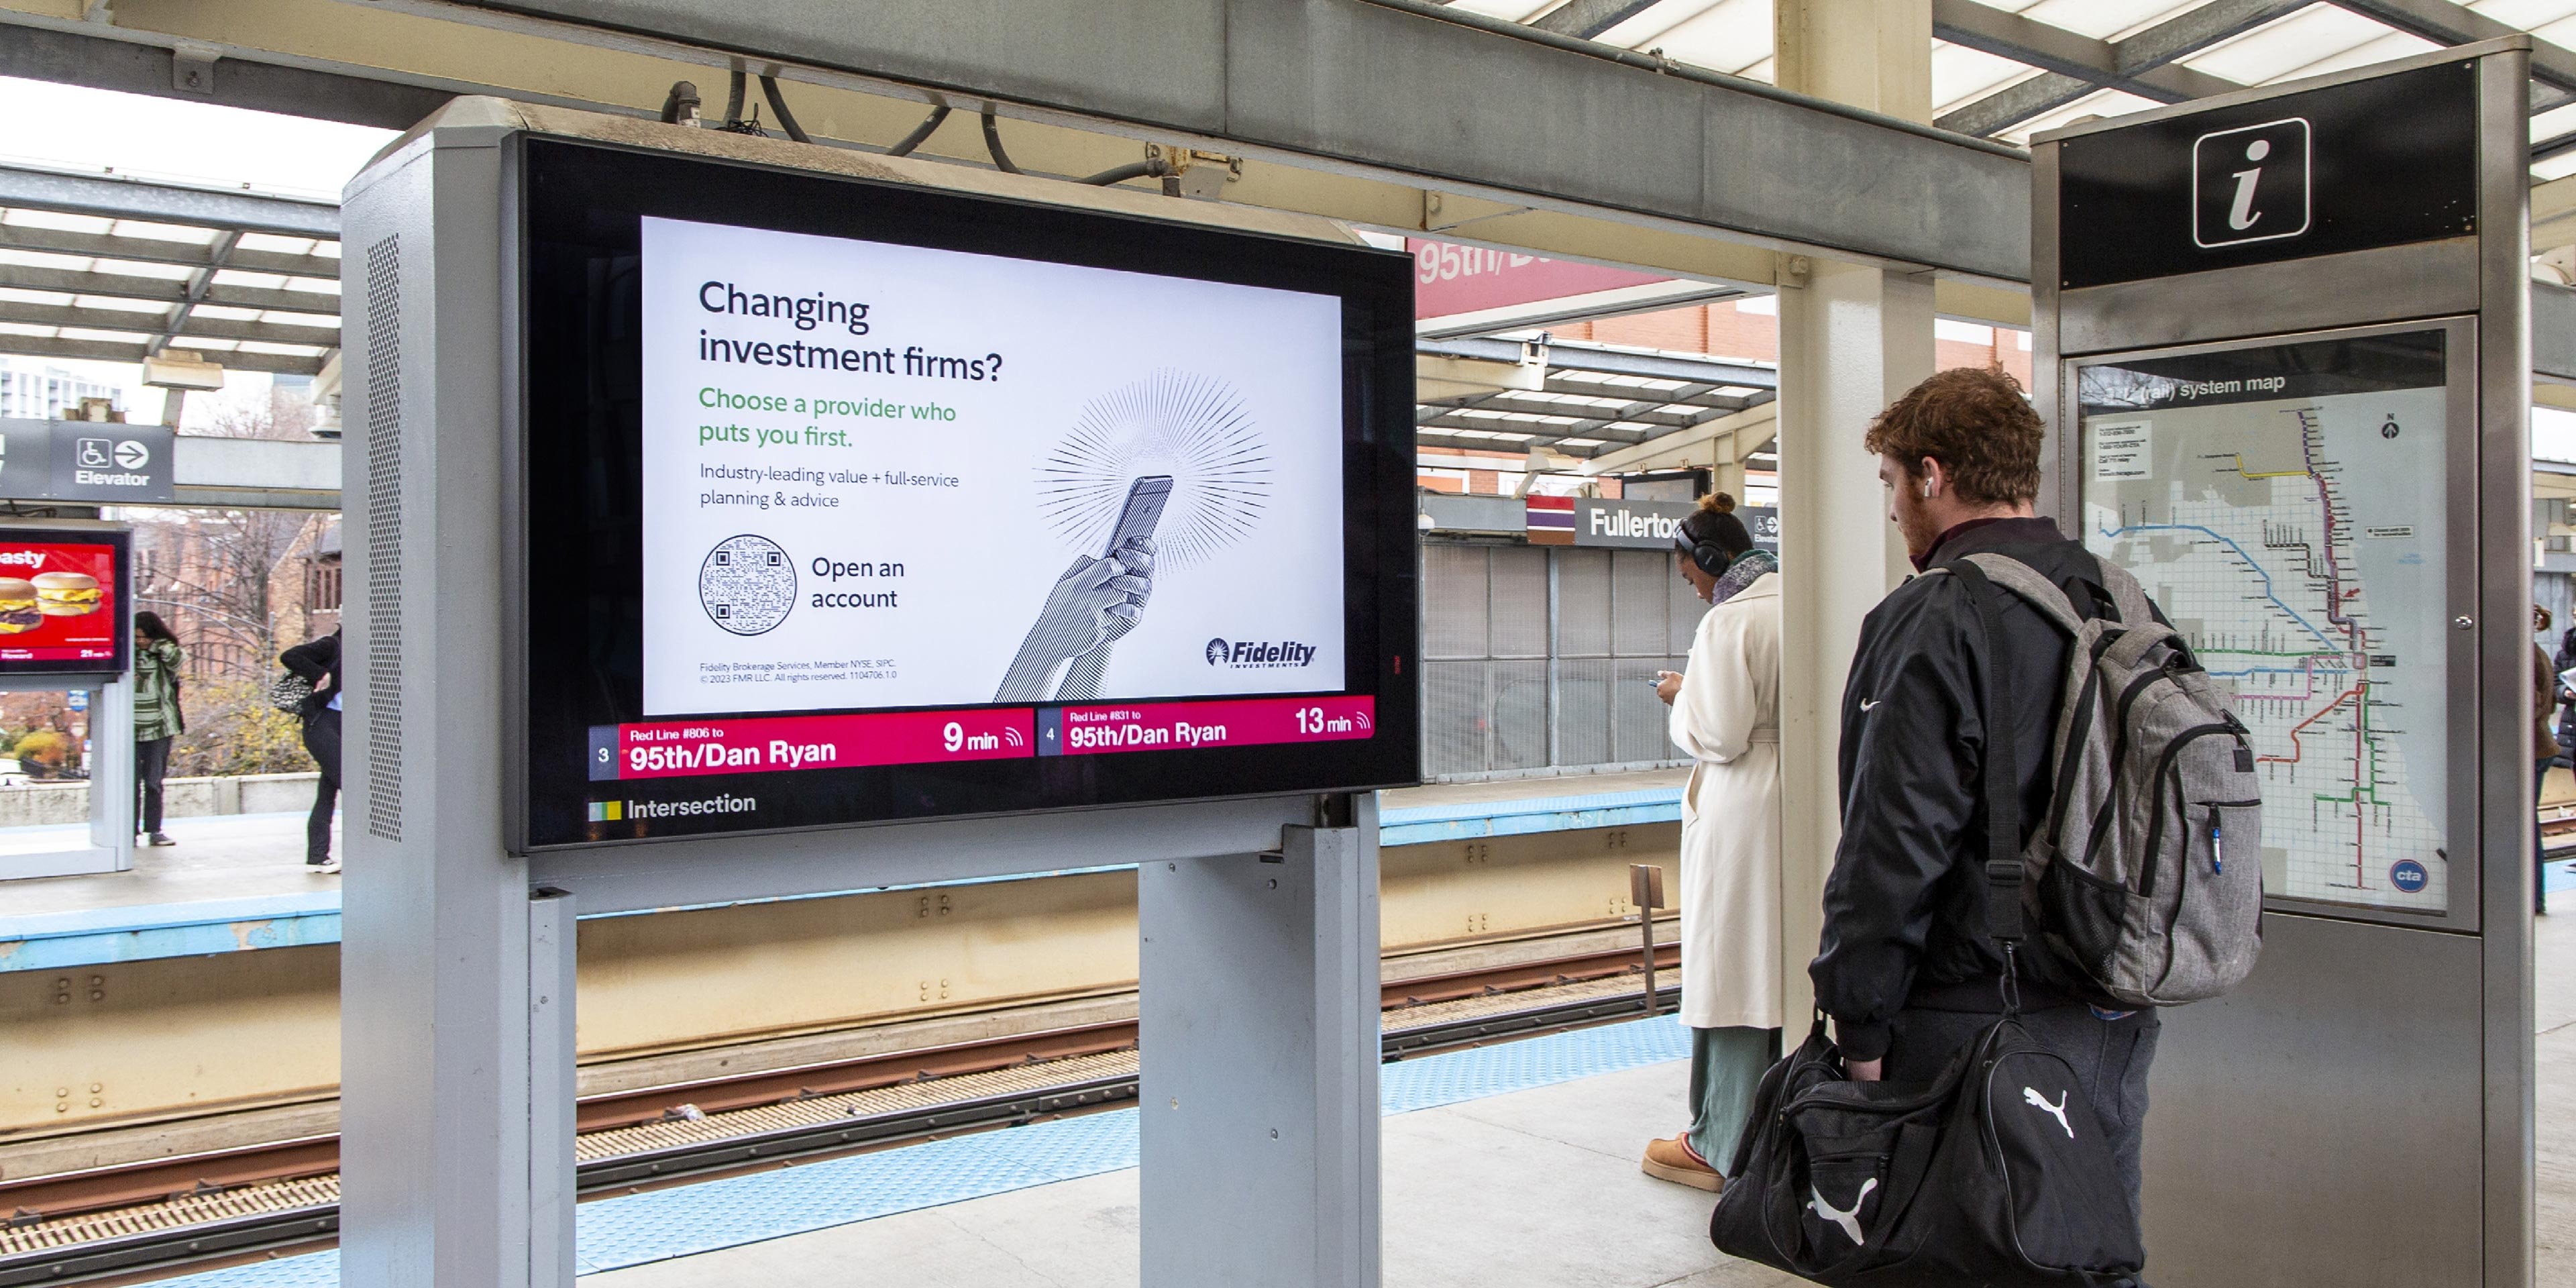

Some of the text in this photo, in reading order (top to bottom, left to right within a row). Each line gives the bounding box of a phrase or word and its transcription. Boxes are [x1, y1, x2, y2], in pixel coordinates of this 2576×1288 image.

[700, 281, 869, 335] Changing
[700, 329, 1002, 382] investment firms?
[2180, 380, 2241, 399] system
[2246, 376, 2286, 392] map
[699, 388, 956, 421] Choose a provider who
[700, 424, 852, 448] puts you first.
[75, 470, 150, 486] Elevator
[701, 464, 959, 487] Industry-leading value + full-service
[701, 490, 839, 510] planning & advice
[0, 551, 46, 569] asty
[812, 557, 904, 582] Open an
[812, 591, 897, 608] account
[700, 663, 731, 672] Fidelity
[733, 663, 775, 672] Brokerage
[851, 660, 873, 668] NYSE,
[876, 659, 896, 667] SIPC.
[710, 675, 731, 683] 2023
[755, 674, 771, 682] LLC.
[788, 674, 809, 683] rights
[811, 672, 847, 680] reserved.
[1071, 711, 1141, 722] Red Line #831 to
[1295, 707, 1351, 733] 13 min
[631, 728, 724, 741] Red Line #806 to
[943, 722, 998, 751] 9 min
[1046, 731, 1055, 741] 4
[1070, 722, 1226, 747] 95th/Dan Ryan
[598, 747, 610, 762] 3
[630, 740, 836, 771] 95th/Dan Ryan
[628, 794, 756, 819] Intersection
[2396, 870, 2422, 881] cta
